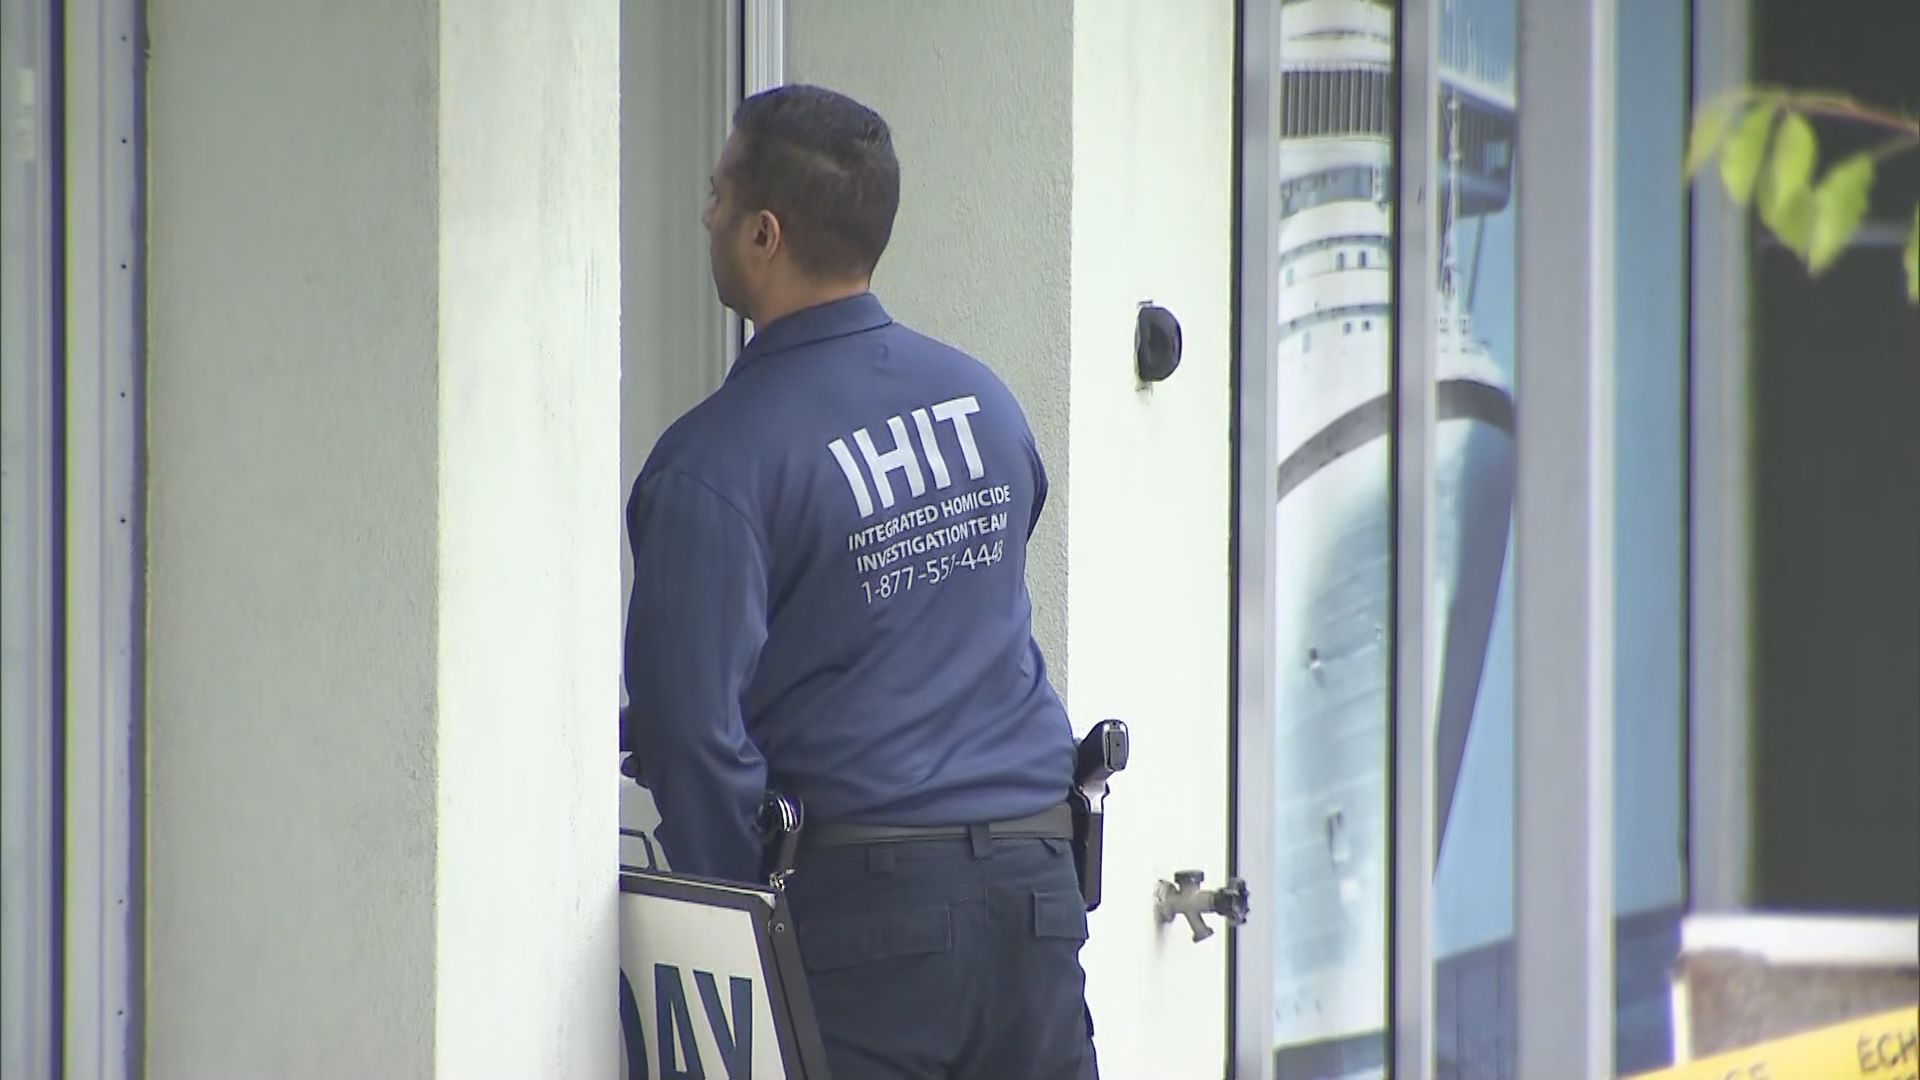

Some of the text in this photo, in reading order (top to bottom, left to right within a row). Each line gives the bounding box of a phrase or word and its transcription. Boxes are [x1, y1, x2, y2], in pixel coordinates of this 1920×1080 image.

[828, 395, 985, 518] IHIT
[849, 485, 1011, 551] INTEGRATED HOMICIDE
[857, 524, 969, 574] INVESTIGATION
